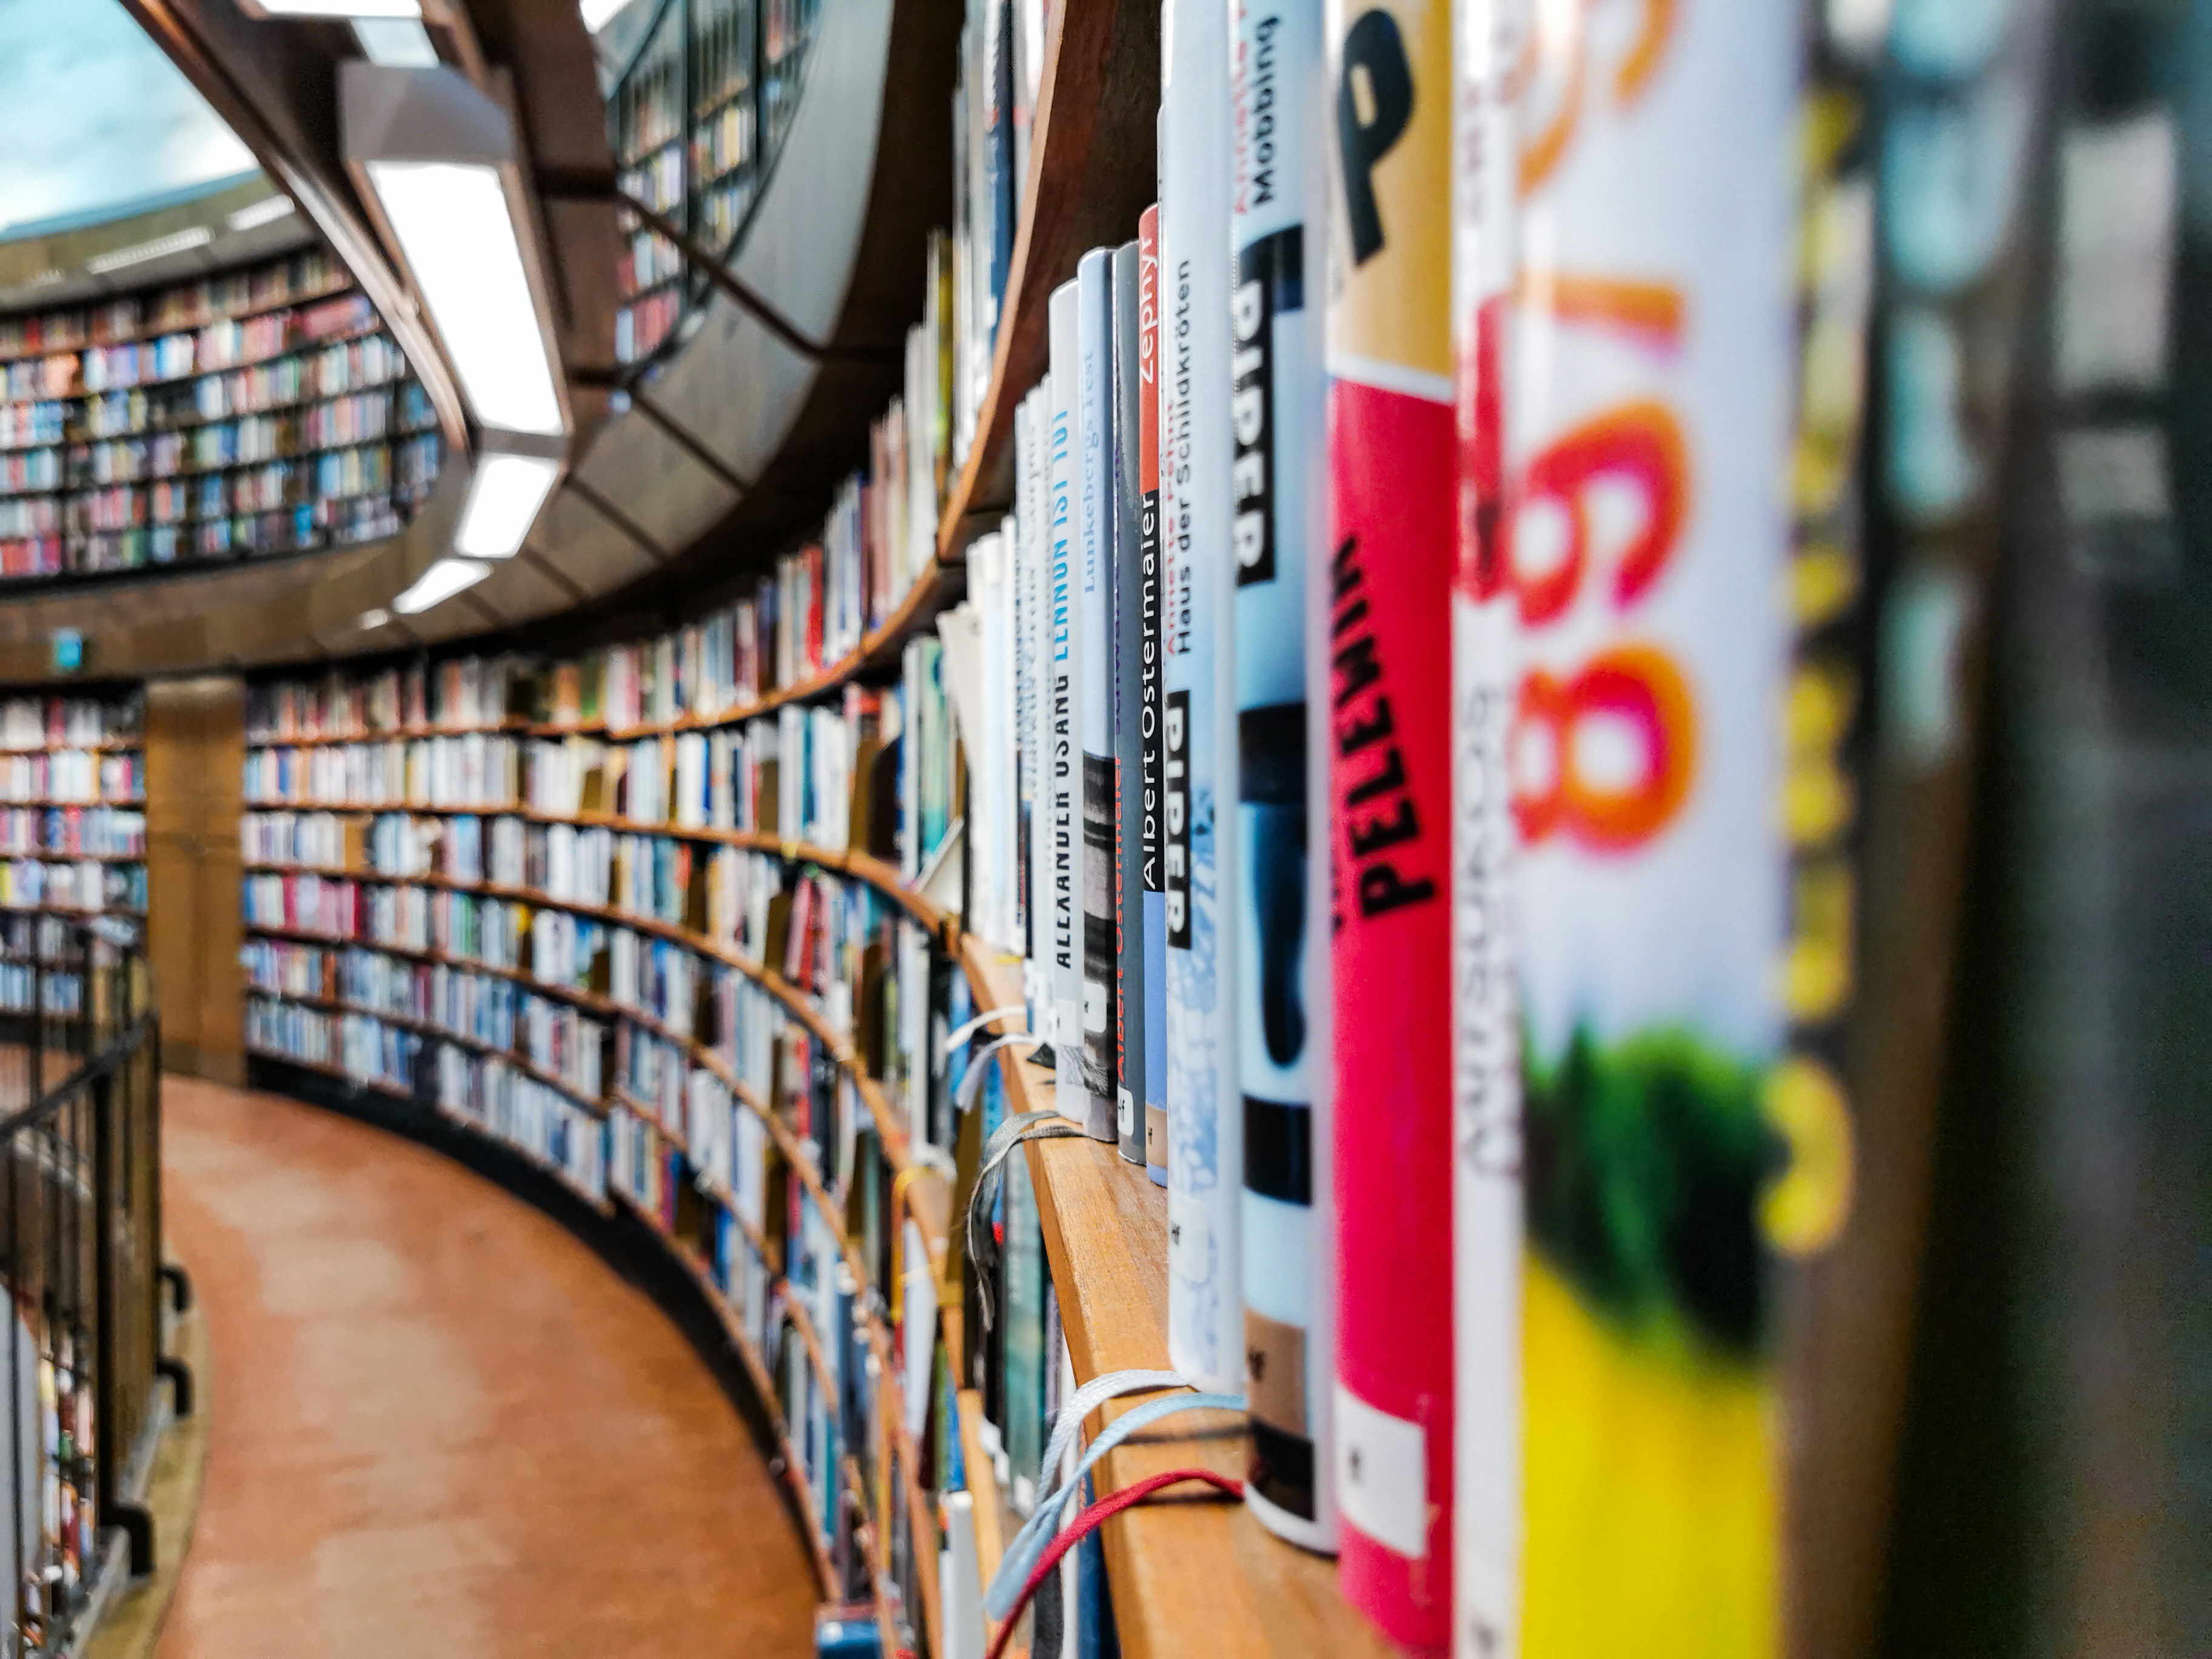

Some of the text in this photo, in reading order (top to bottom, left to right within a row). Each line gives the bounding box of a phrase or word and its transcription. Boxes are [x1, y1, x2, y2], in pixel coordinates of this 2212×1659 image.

[1251, 16, 1281, 209] Mobbing
[1139, 237, 1158, 389] Zephyr
[1084, 420, 1099, 594] Lunkebergs
[1175, 259, 1191, 655] Haus der Schildkröten
[1233, 280, 1265, 568] PIPER
[1053, 538, 1068, 661] LENNON
[1141, 493, 1156, 890] Albert Ostermaier
[1054, 675, 1070, 778] OSANG
[1167, 703, 1185, 934] PIPER
[1056, 793, 1071, 970] ALEXANDER
